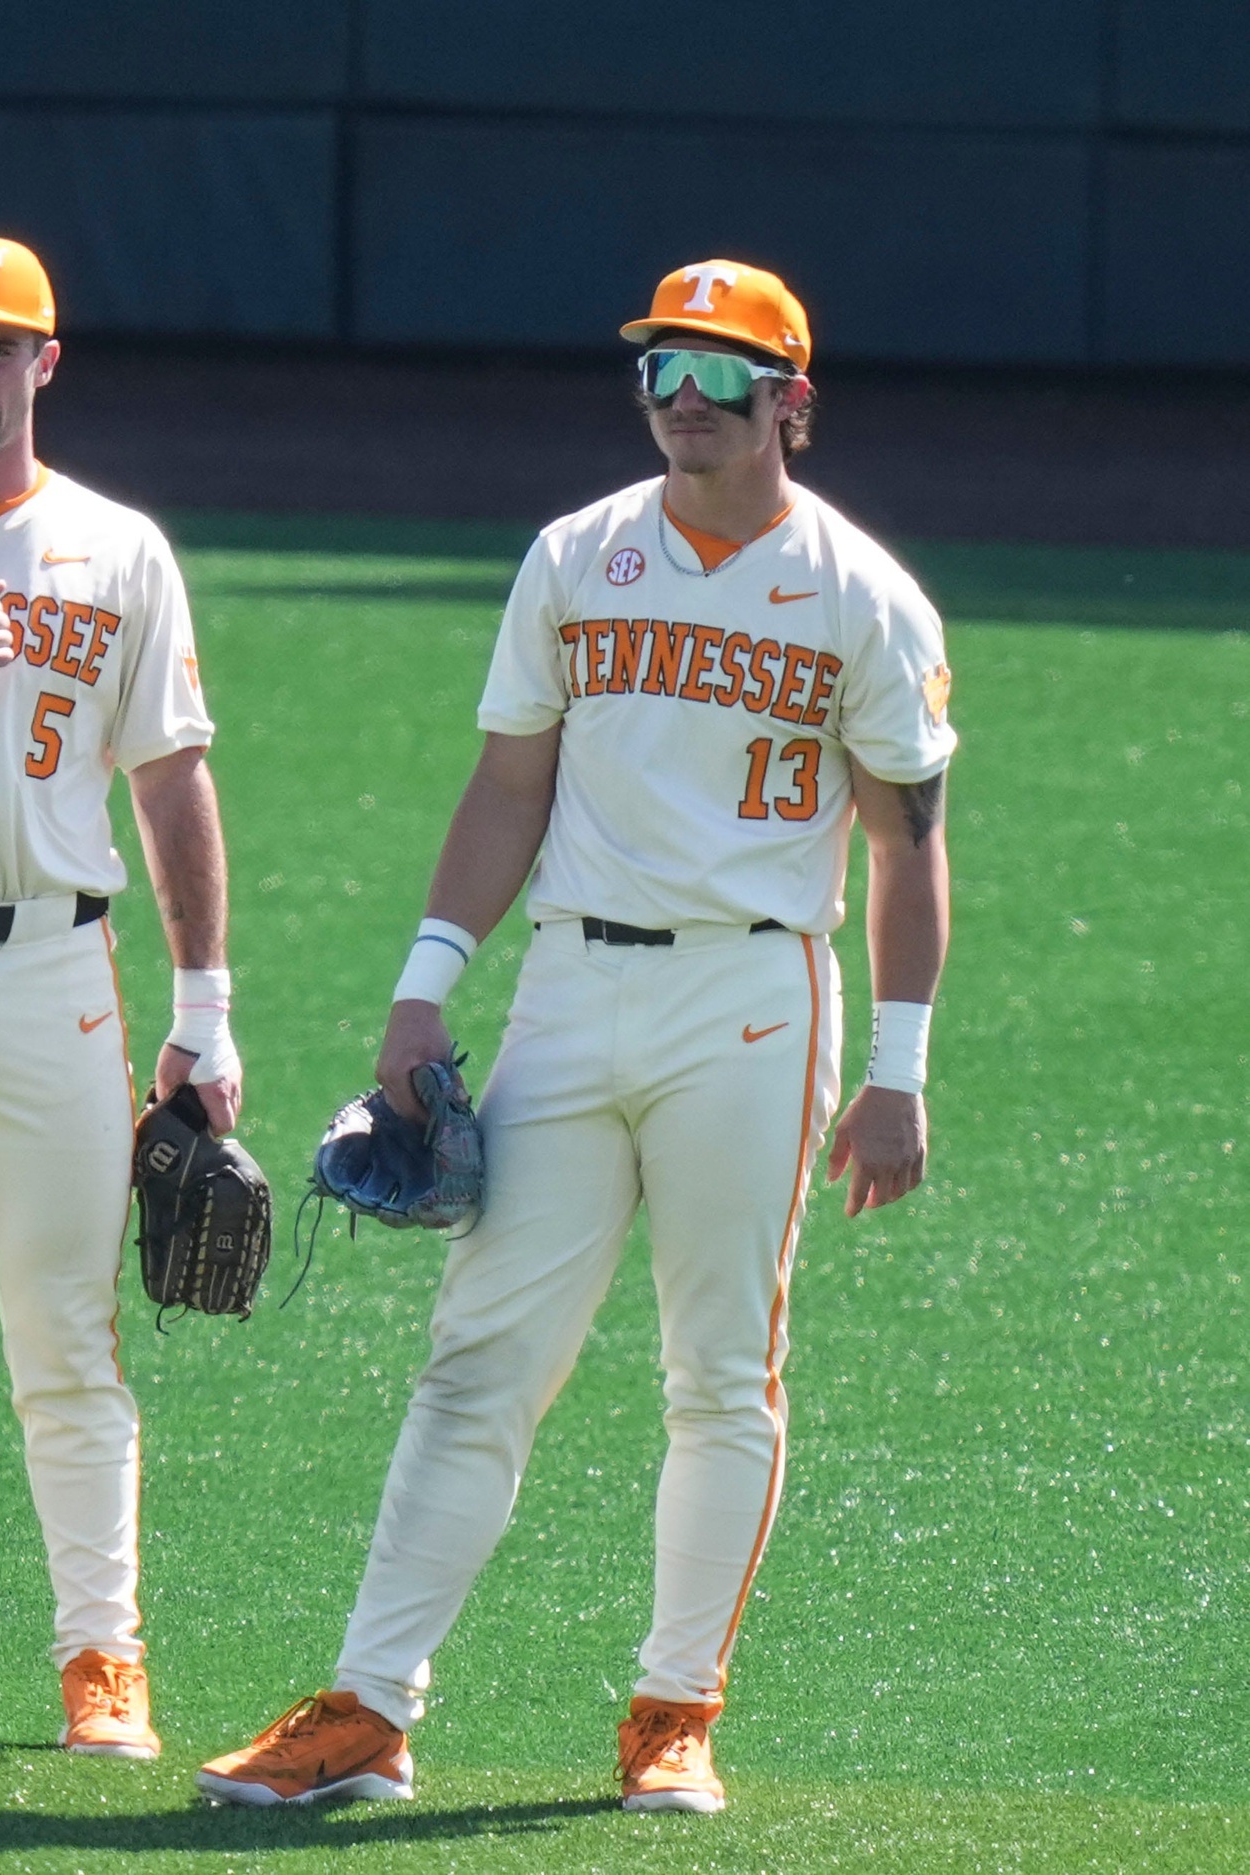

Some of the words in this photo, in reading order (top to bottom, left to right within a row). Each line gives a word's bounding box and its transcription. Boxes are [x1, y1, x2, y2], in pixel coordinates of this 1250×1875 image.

[683, 265, 739, 314] T
[607, 548, 645, 585] SEC
[559, 618, 843, 726] TENNESSEE
[25, 691, 76, 780] 5
[738, 738, 823, 821] 13
